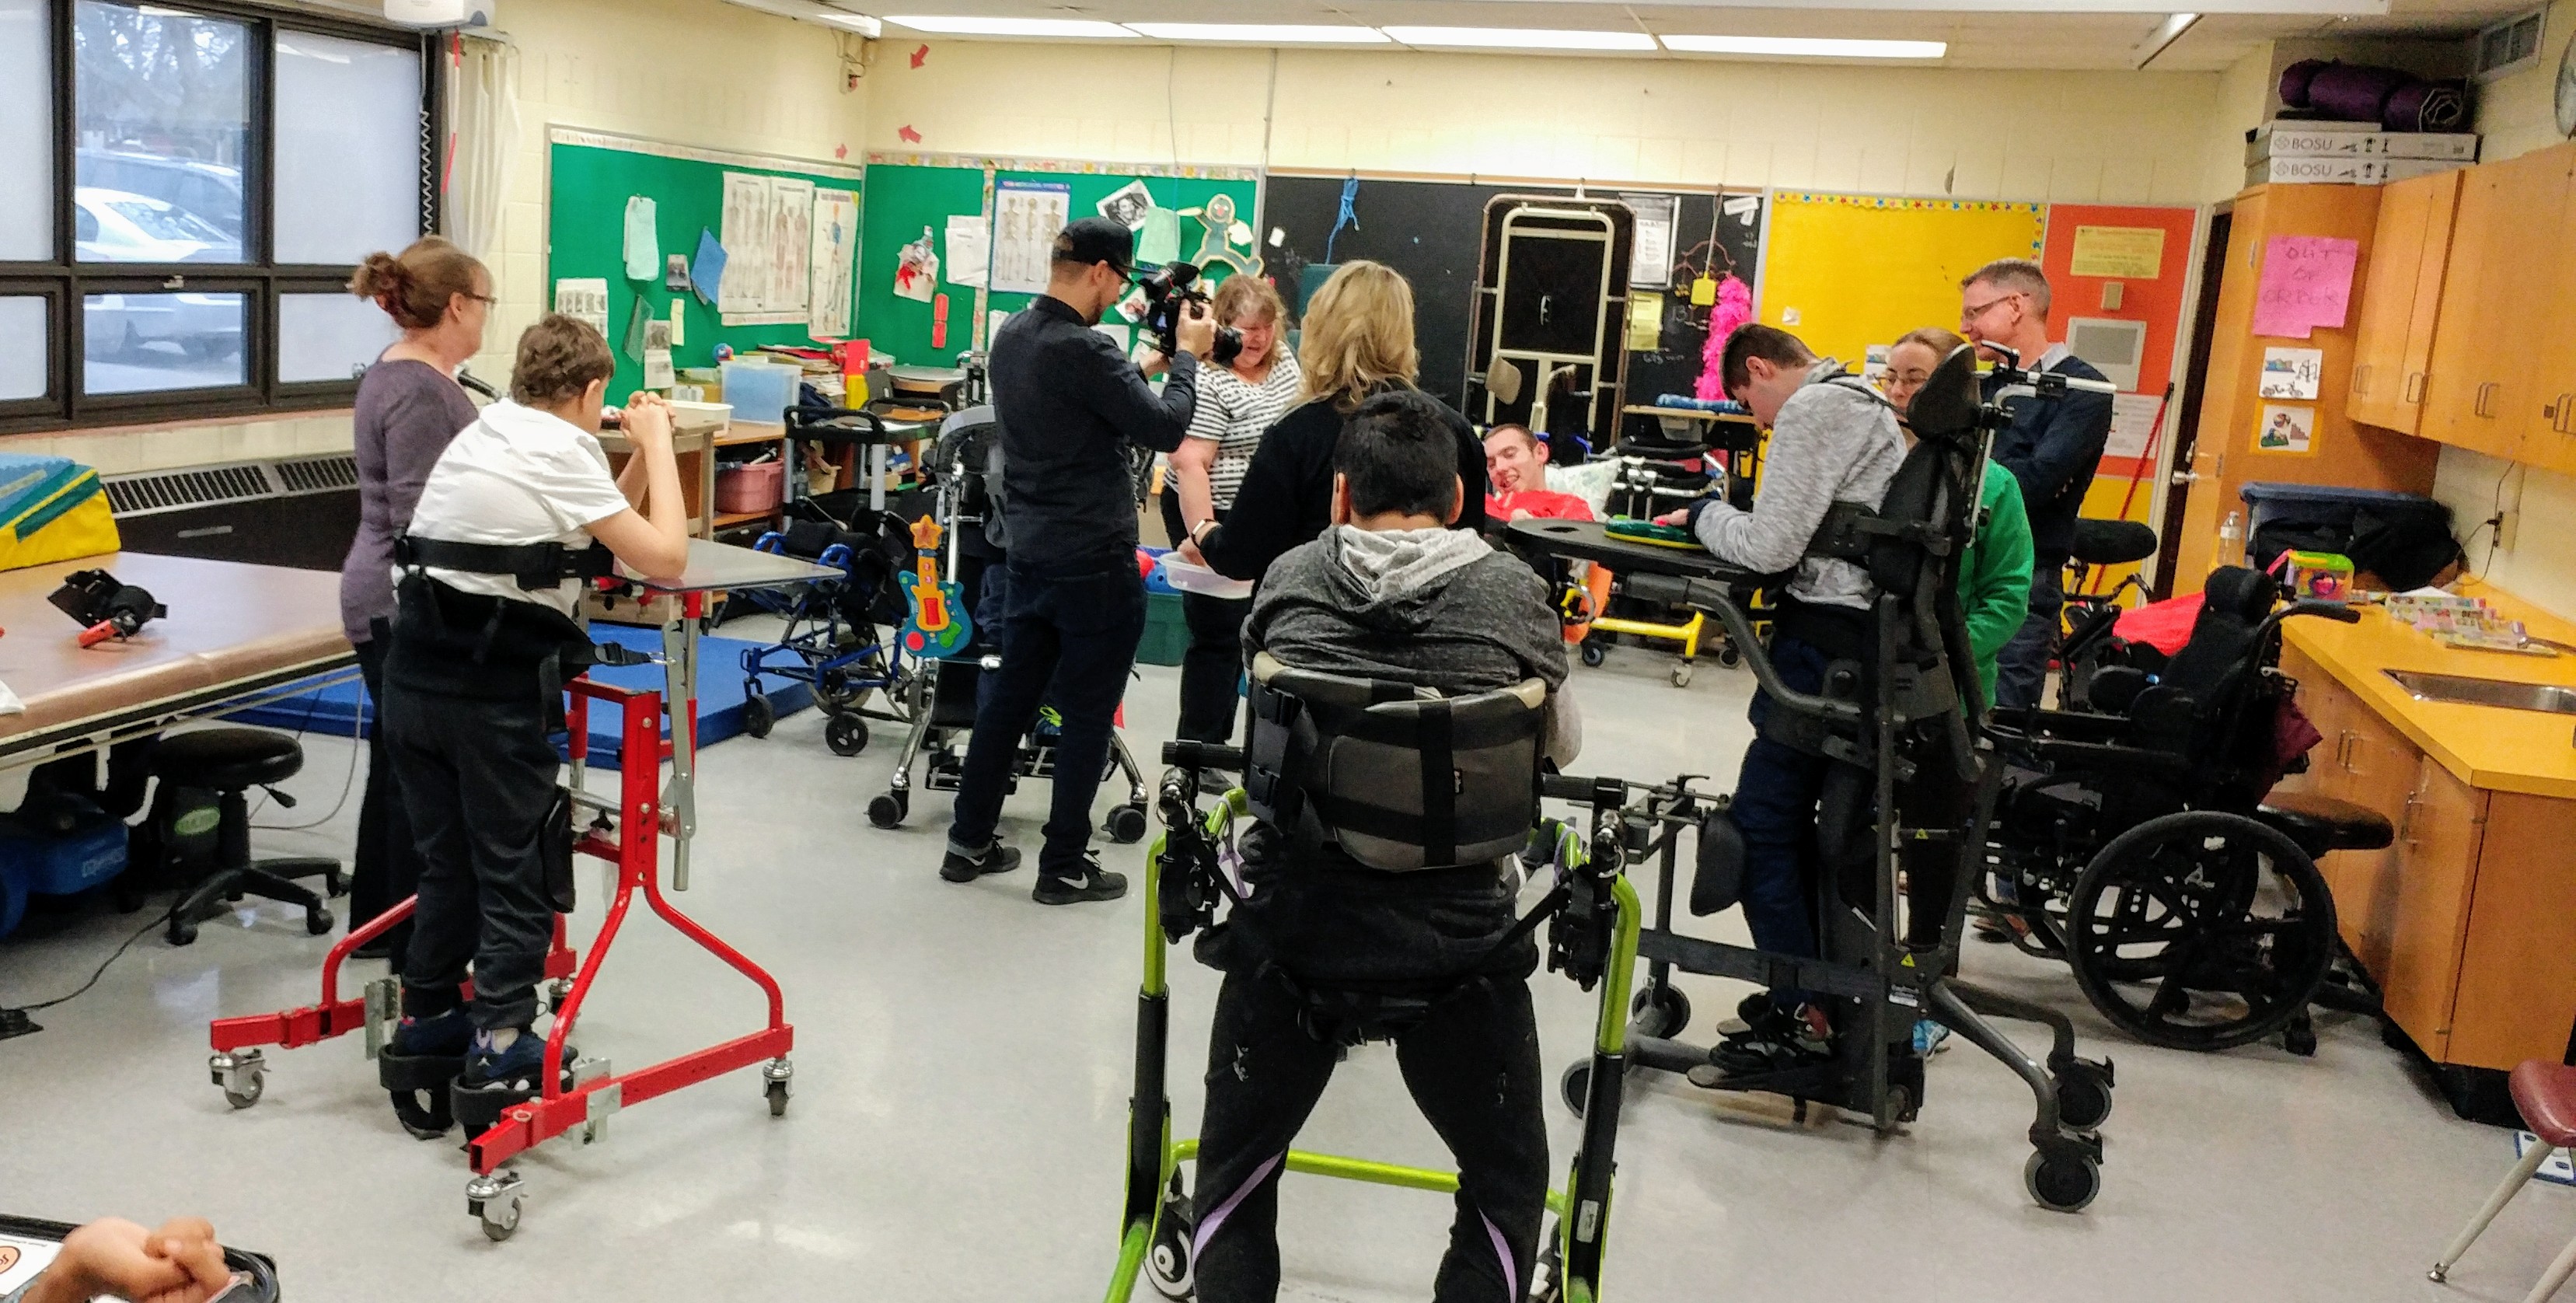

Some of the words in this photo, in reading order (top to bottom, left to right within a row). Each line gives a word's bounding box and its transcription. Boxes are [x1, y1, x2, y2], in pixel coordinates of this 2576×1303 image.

[2292, 138, 2333, 150] BOSU
[2291, 163, 2332, 176] BOSU
[2286, 246, 2340, 260] OUT
